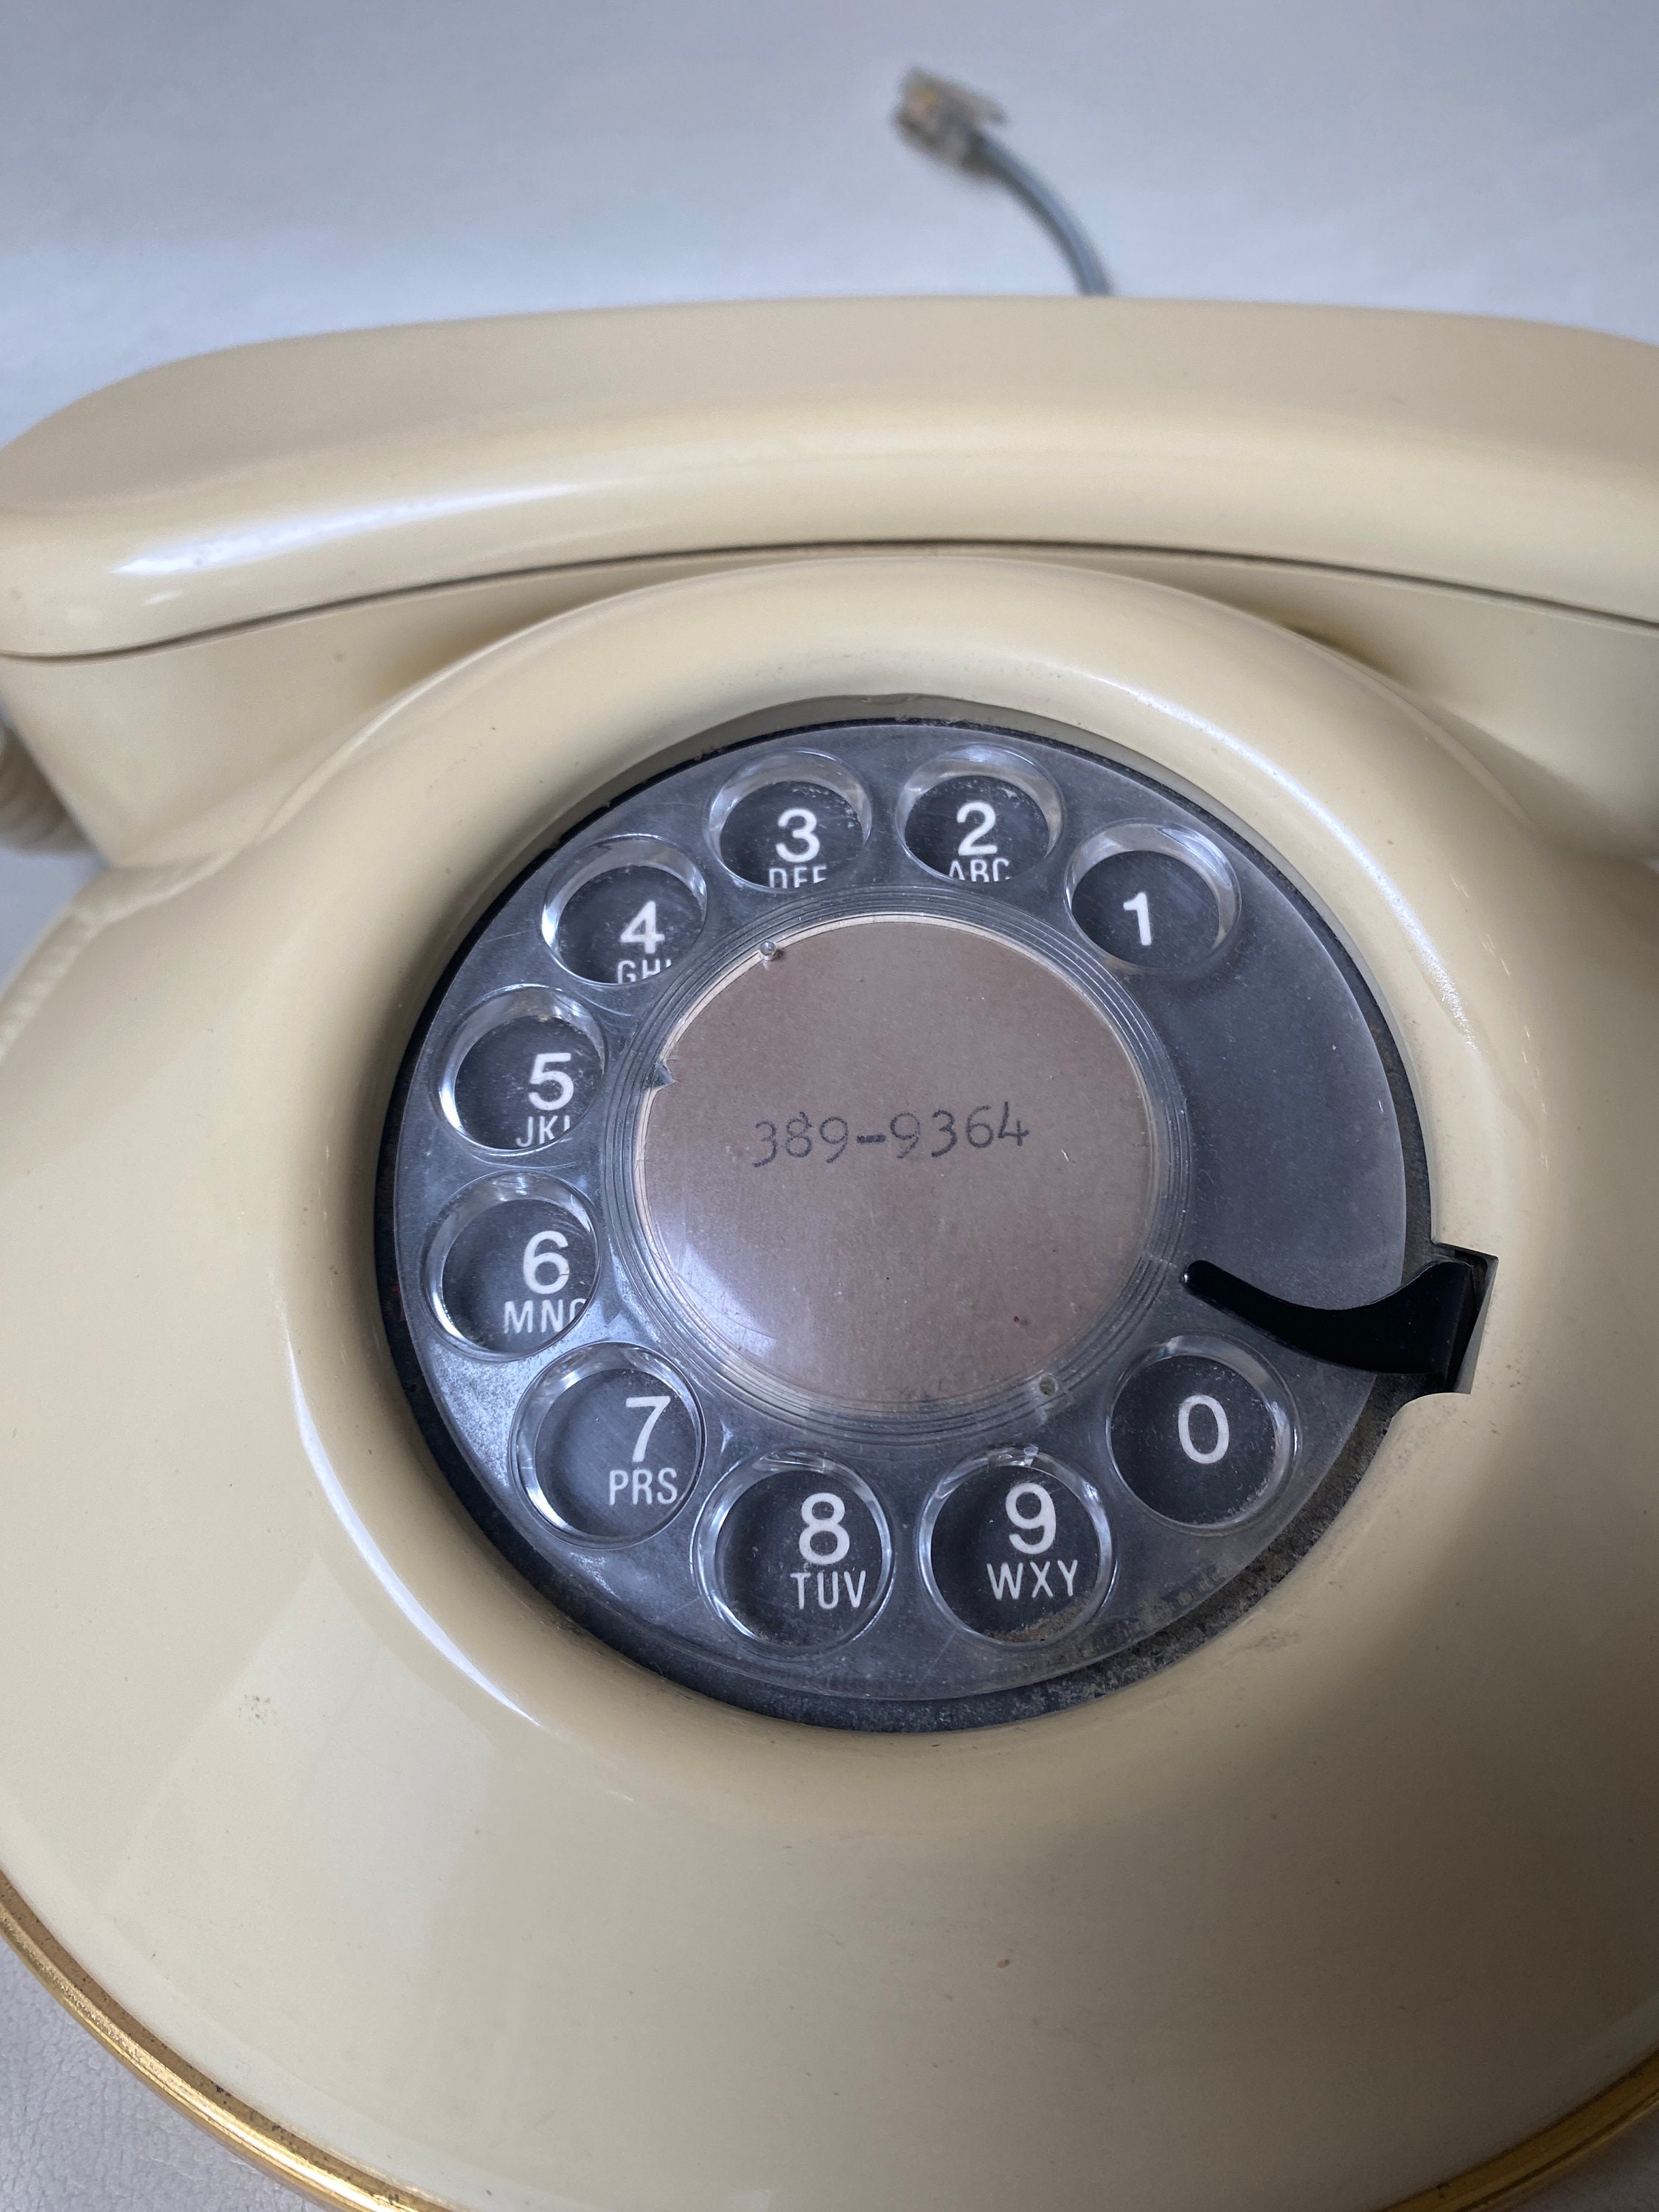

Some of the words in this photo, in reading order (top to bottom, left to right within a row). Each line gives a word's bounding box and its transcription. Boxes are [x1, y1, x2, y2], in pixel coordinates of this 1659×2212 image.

[776, 807, 820, 863] 3
[956, 800, 998, 856] 2
[620, 900, 665, 954] 4
[1123, 891, 1152, 946] 1
[529, 1052, 574, 1111] 5
[751, 1101, 1030, 1168] 389-9364
[523, 1230, 570, 1295] 6
[625, 1395, 671, 1463] 7
[1178, 1394, 1230, 1464] 0
[608, 1467, 678, 1506] PRS
[798, 1492, 850, 1565] 8
[1006, 1482, 1057, 1555] 9
[790, 1570, 866, 1610] TUV
[987, 1559, 1078, 1600] WXY
